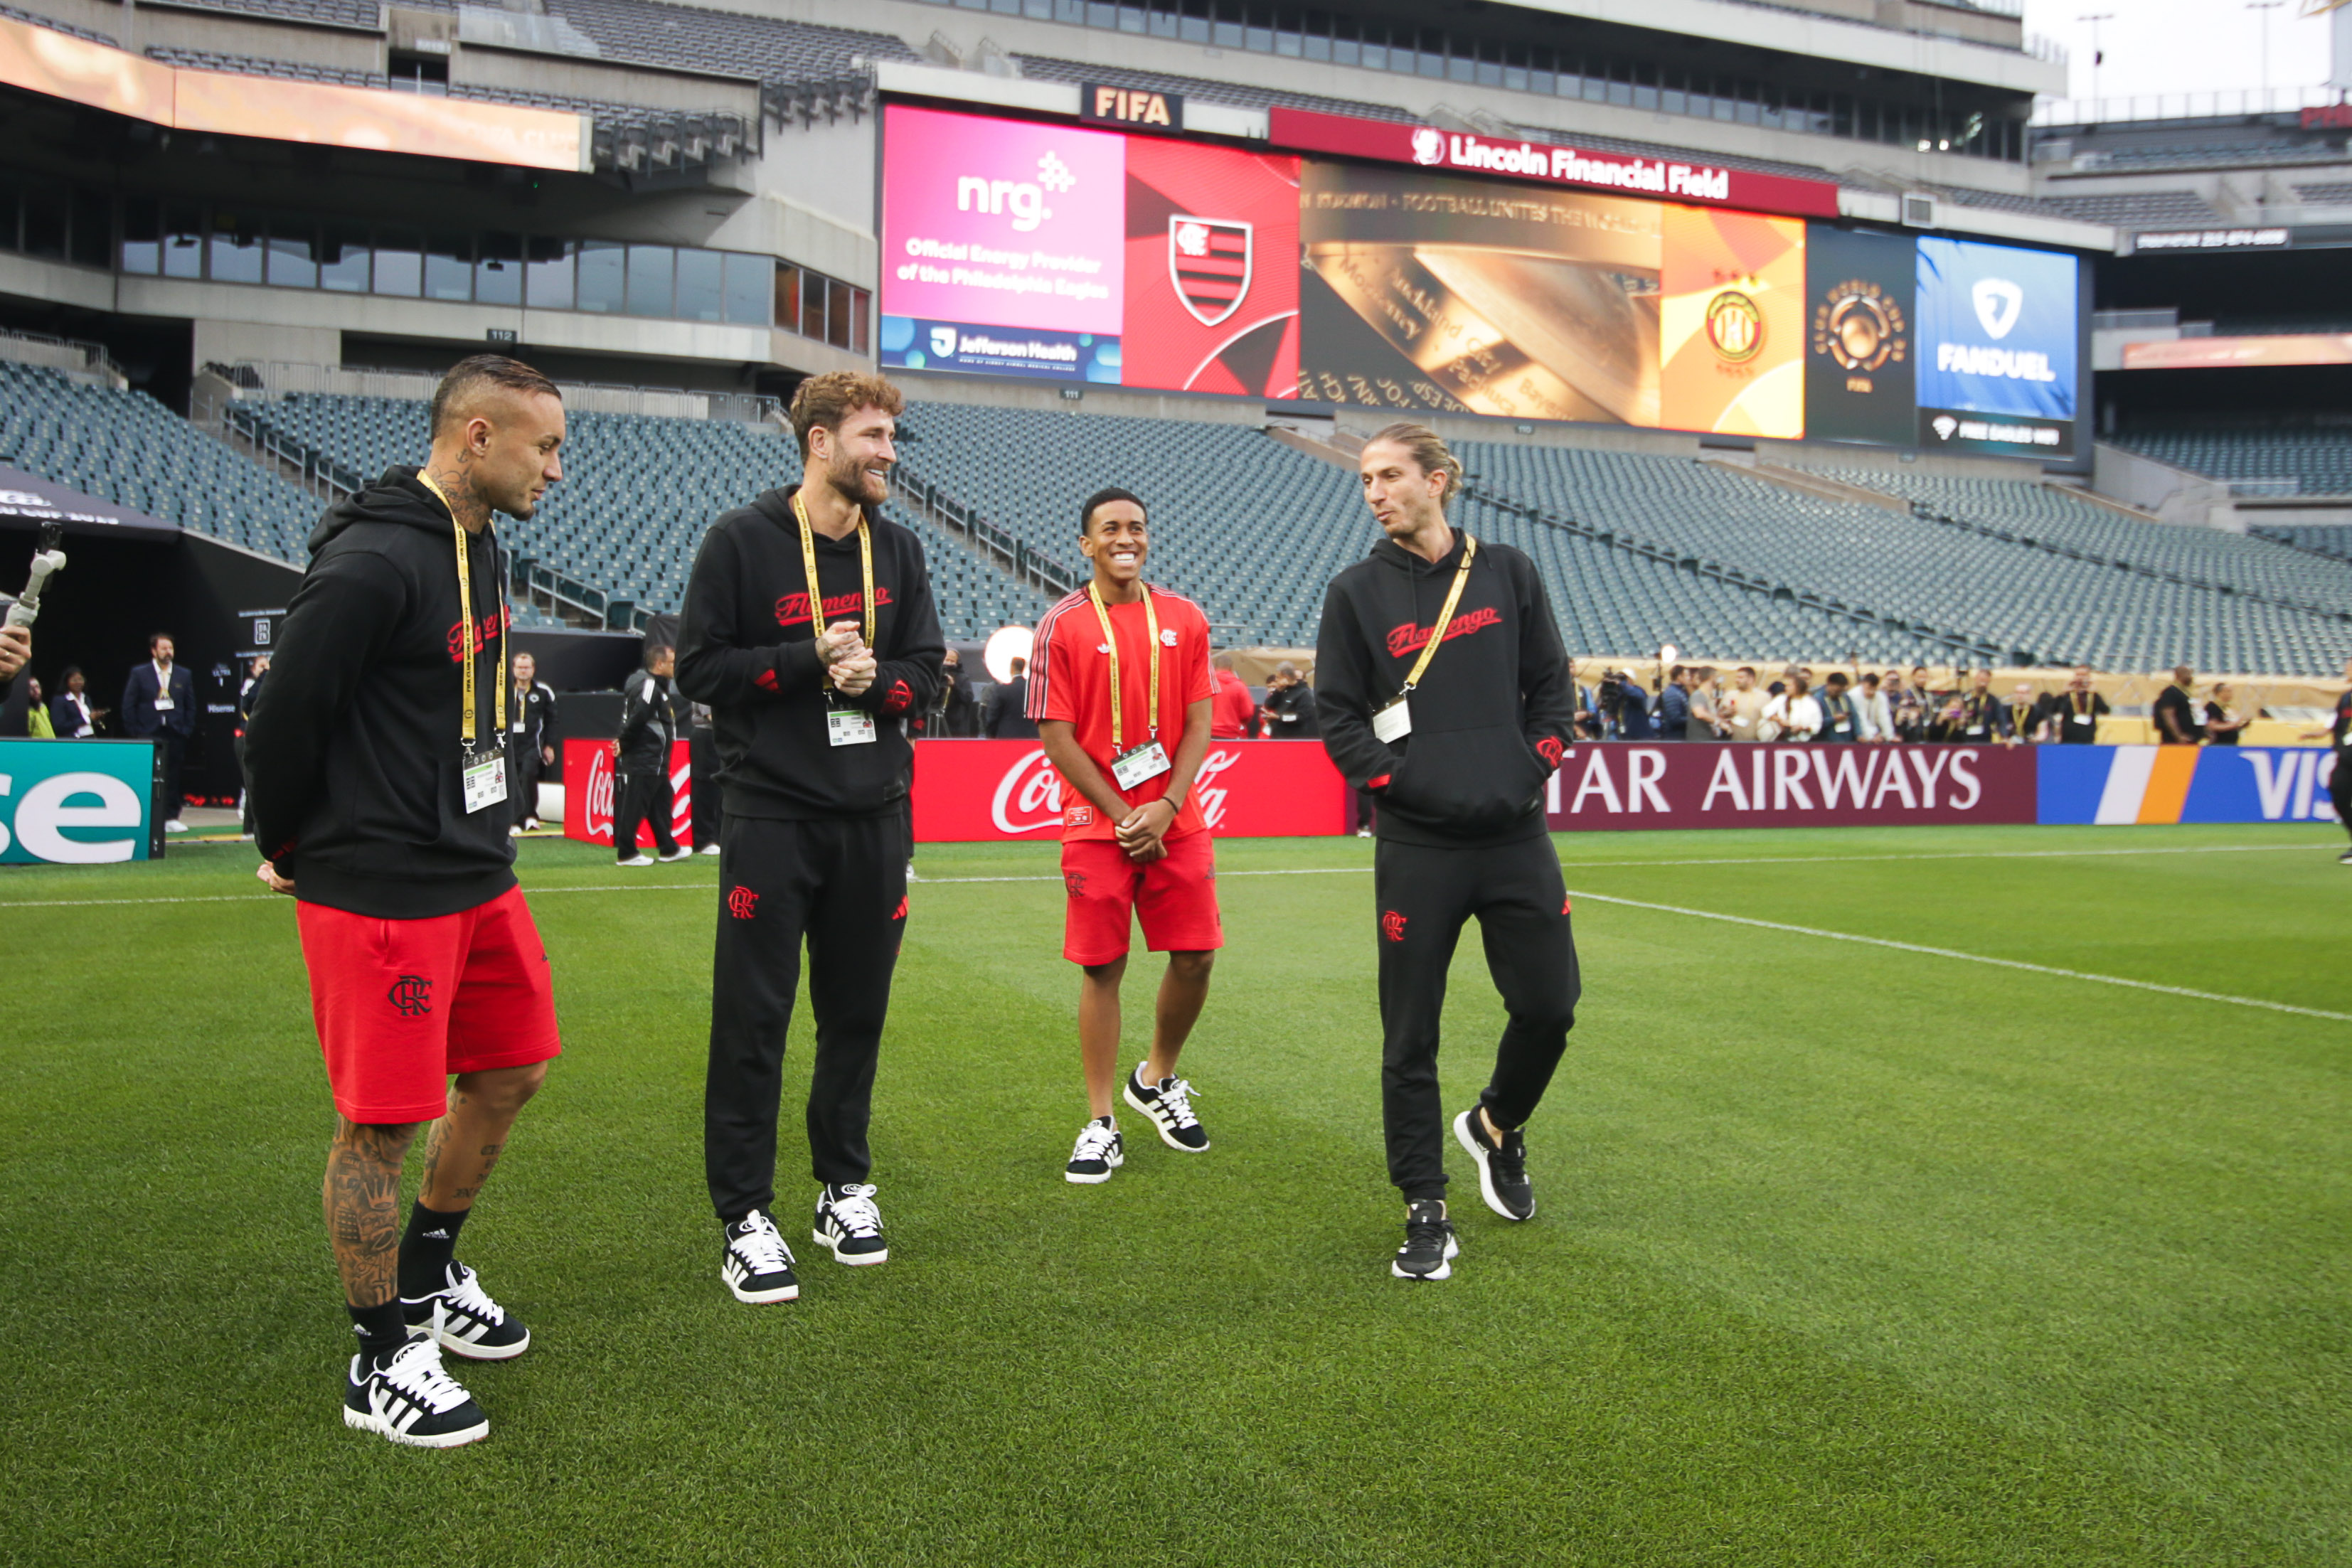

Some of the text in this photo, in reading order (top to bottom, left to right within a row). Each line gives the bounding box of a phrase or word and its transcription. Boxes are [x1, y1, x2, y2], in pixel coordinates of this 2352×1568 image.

[1095, 87, 1171, 125] FIFA
[1450, 135, 1729, 201] Lincoln Financial Field
[1550, 206, 1583, 227] THE
[905, 236, 1102, 274] Official Energy Provider
[897, 262, 1110, 300] of the Philadelphia Eagles
[1385, 265, 1464, 339] Auckland
[491, 329, 513, 341] 112
[959, 334, 1078, 362] Jefferson Health
[1937, 341, 2056, 383] FANDUEL
[1065, 390, 1079, 399] 111
[1448, 358, 1518, 415] Pachuca
[208, 704, 235, 713] Hisense
[1701, 747, 1982, 812] AIRWAYS
